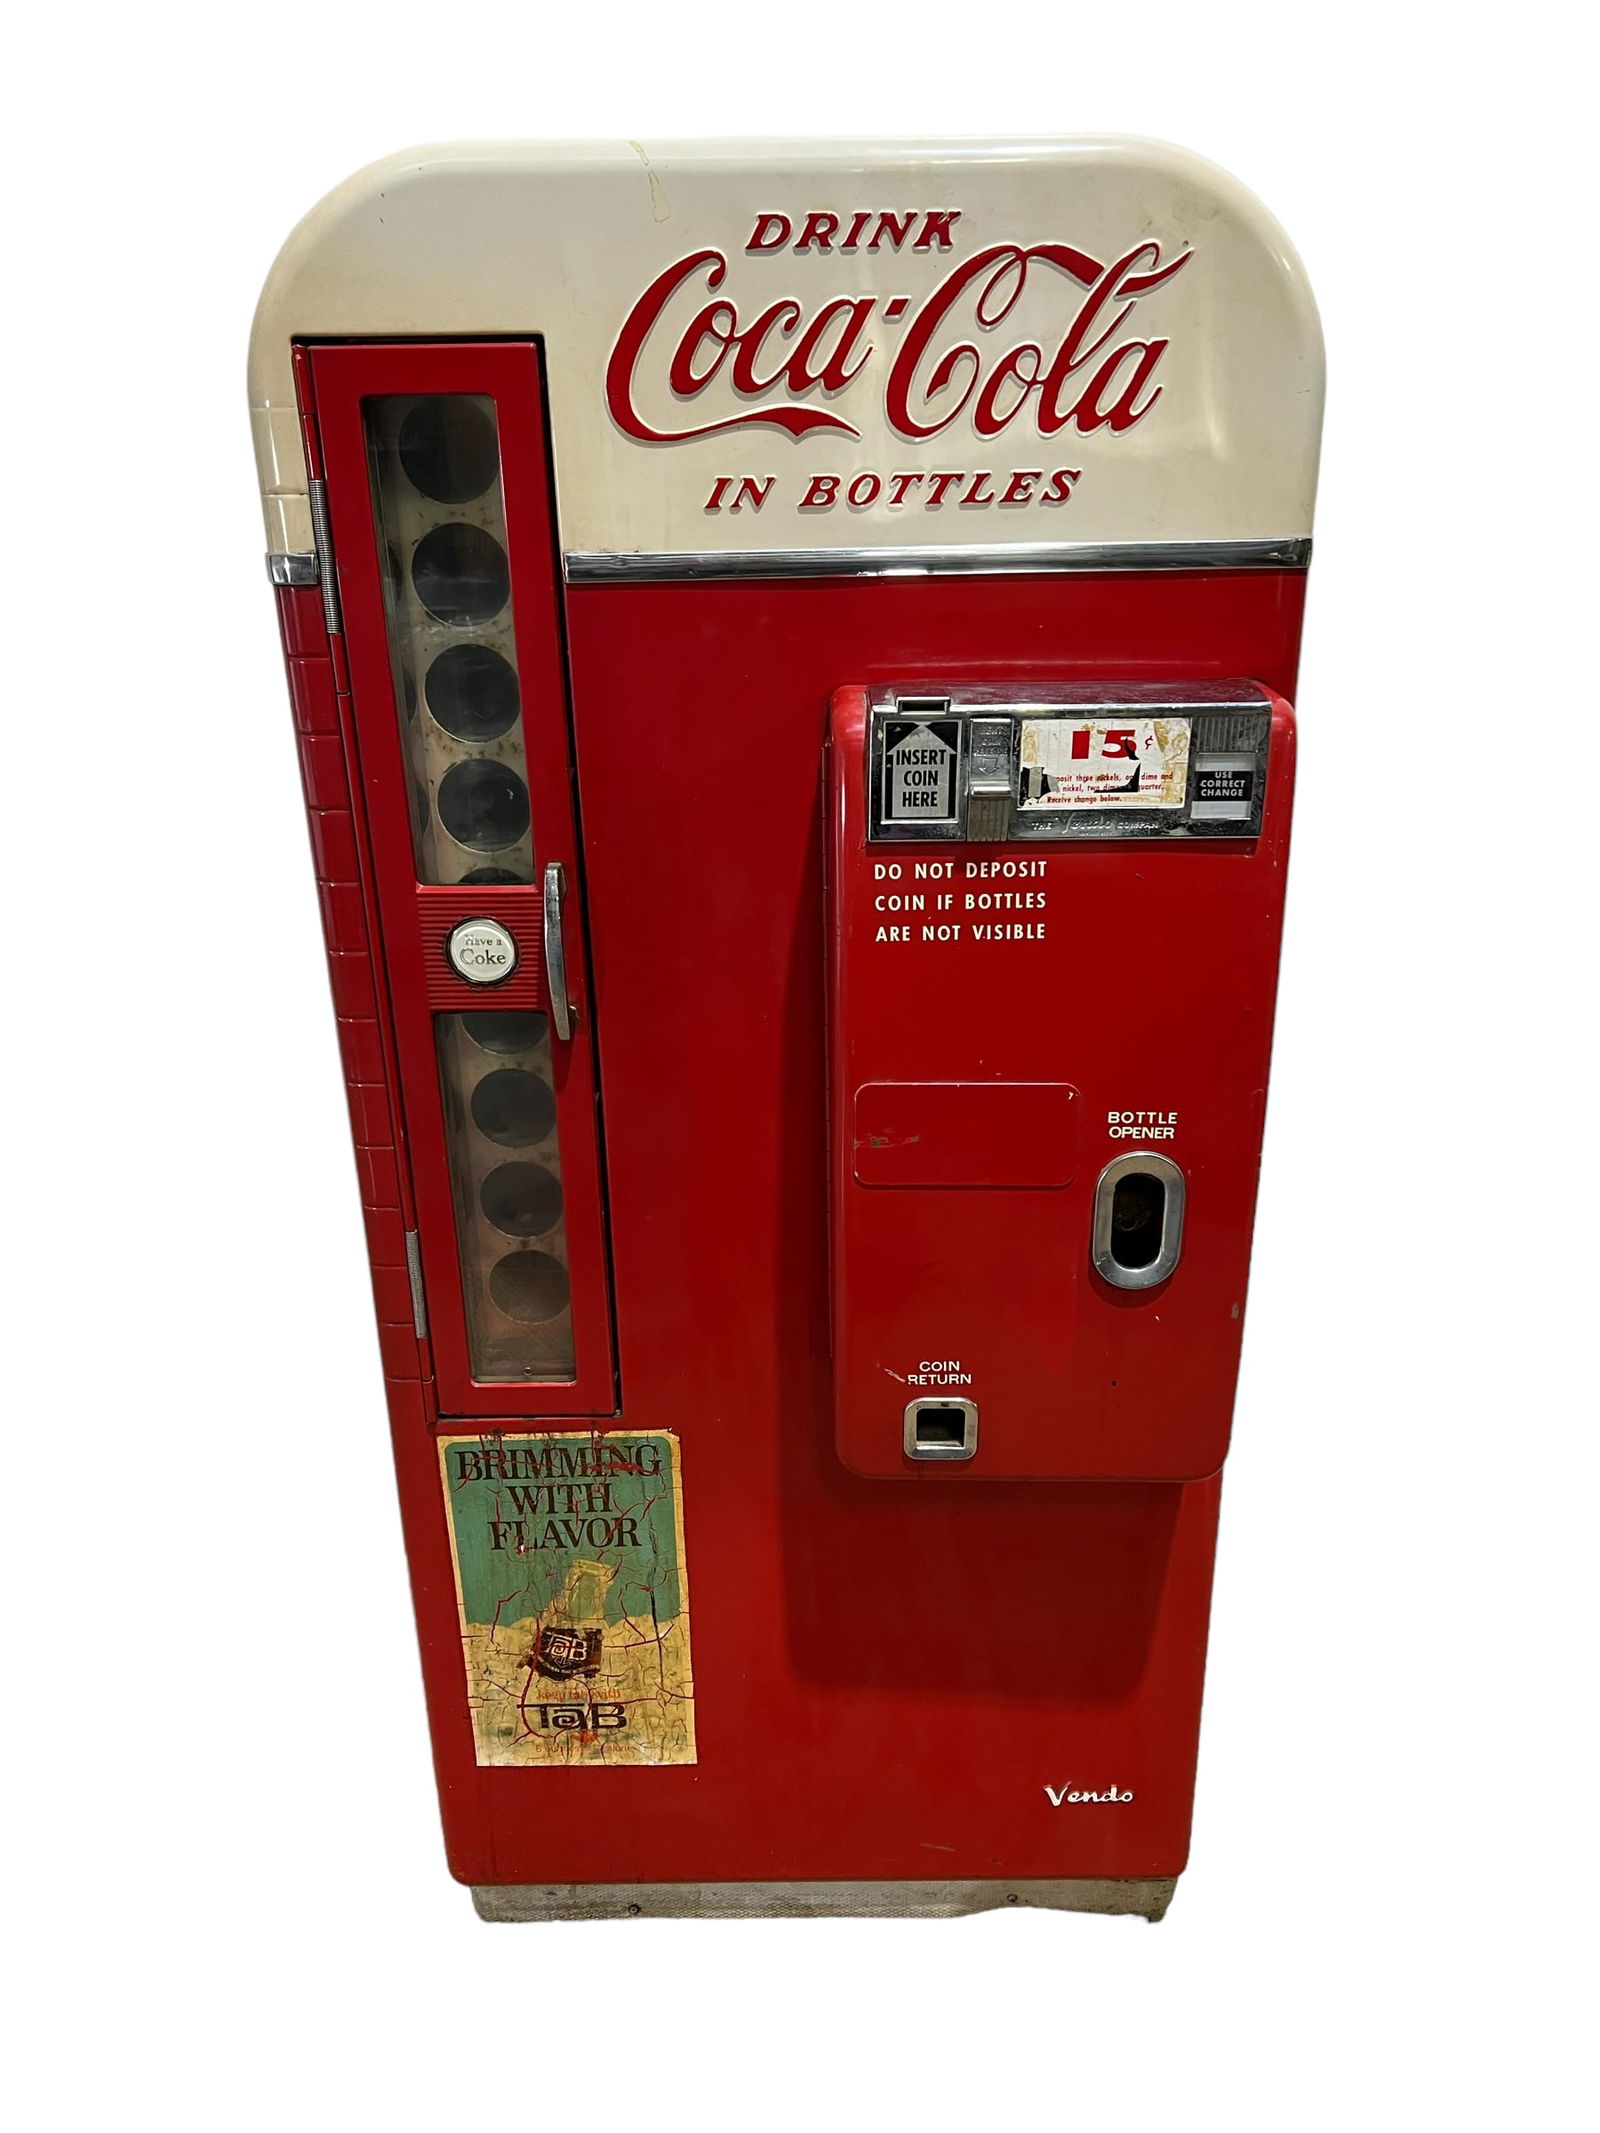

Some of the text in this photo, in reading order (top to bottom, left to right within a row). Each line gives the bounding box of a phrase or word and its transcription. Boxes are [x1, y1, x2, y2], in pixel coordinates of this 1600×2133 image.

[747, 211, 960, 249] DRINK
[605, 242, 1193, 442] Coca-Cola
[704, 469, 1081, 510] IN BOTTLES
[896, 749, 946, 765] INSERT
[904, 770, 938, 786] COIN
[1141, 772, 1157, 780] dime
[1161, 772, 1173, 780] and
[1215, 771, 1233, 779] USE
[1062, 784, 1084, 792] nickel,
[1200, 780, 1245, 788] CORRECT
[902, 791, 938, 807] HERE
[1046, 796, 1071, 804] Receive
[1074, 795, 1097, 804] change
[1201, 789, 1243, 797] CHANGE
[874, 861, 1048, 880] DO NOT DEPOSIT
[875, 892, 1046, 911] COIN IF BOTTLES
[464, 934, 493, 946] Have
[875, 923, 1045, 942] ARE NOT VISIBLE
[460, 948, 507, 965] Coke
[1107, 1111, 1178, 1124] BOTTLE
[1108, 1126, 1175, 1139] OPENER
[919, 1361, 960, 1372] COIN
[907, 1374, 972, 1385] RETURN
[455, 1444, 662, 1481] BRIMMING
[505, 1483, 613, 1516] WITH
[487, 1517, 642, 1551] FLAVOR
[1042, 1781, 1133, 1806] Vendo
